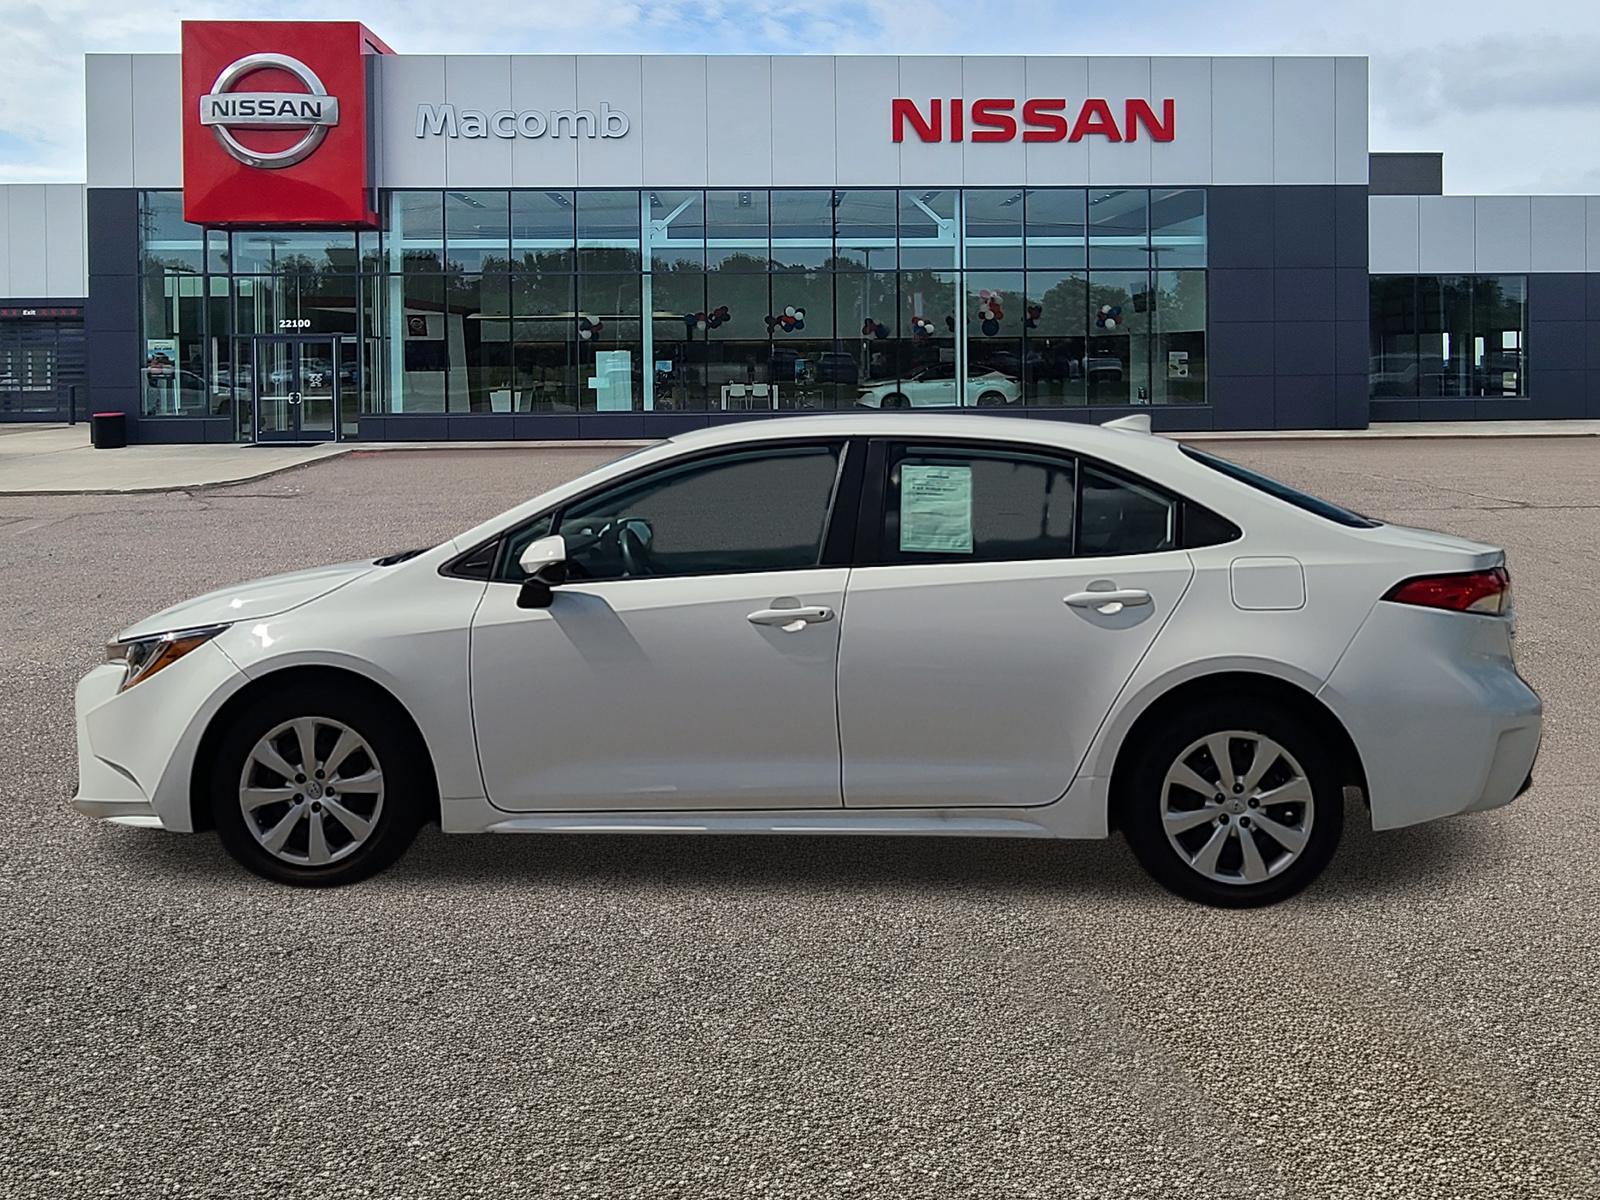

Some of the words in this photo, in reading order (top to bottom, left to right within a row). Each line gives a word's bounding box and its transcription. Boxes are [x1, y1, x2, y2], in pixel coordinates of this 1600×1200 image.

[211, 99, 322, 118] NISSAN
[415, 102, 630, 139] Macomb
[892, 98, 1176, 143] NISSAN
[279, 319, 311, 328] 22100
